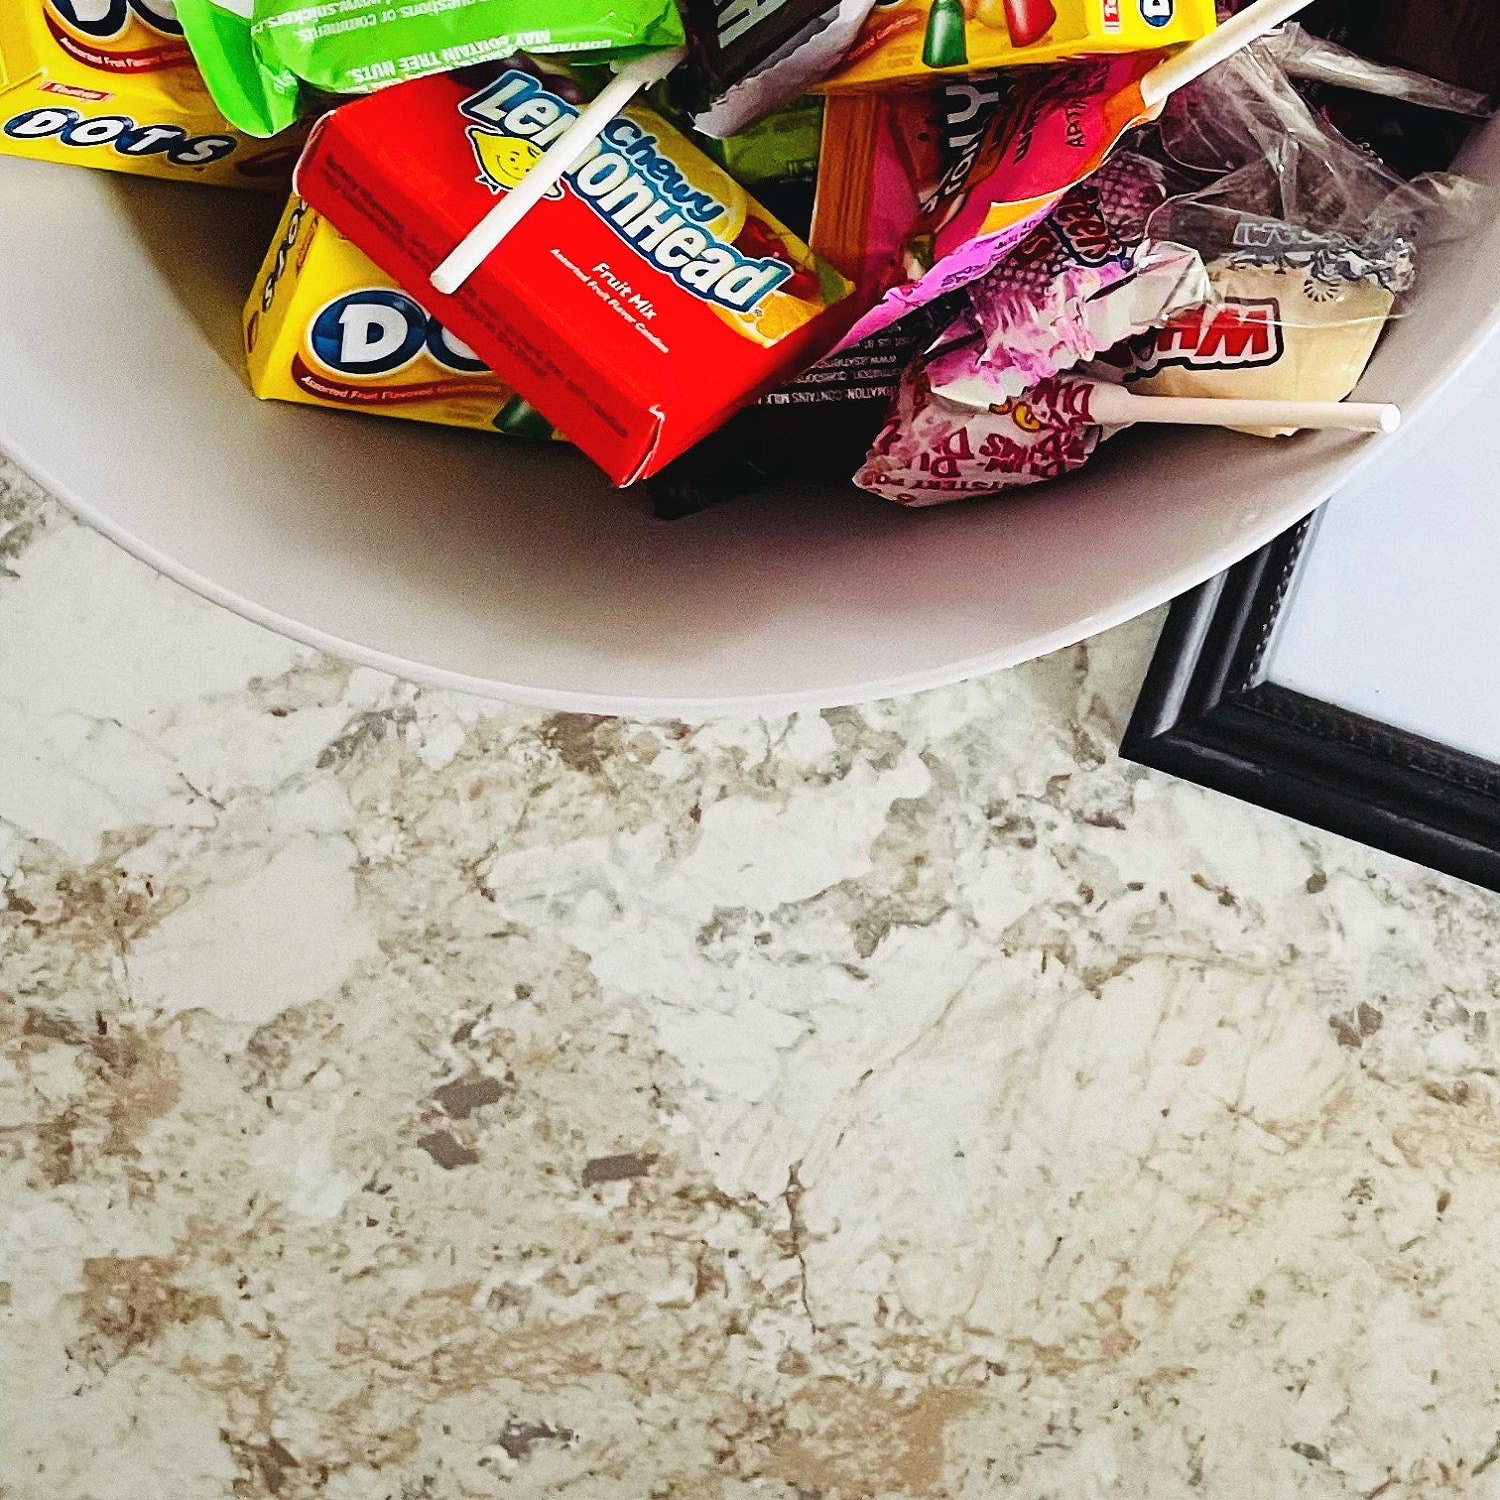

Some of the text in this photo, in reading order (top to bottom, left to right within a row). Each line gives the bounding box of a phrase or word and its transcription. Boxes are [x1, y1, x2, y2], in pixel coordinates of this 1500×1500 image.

[381, 8, 397, 23] or
[440, 35, 510, 62] CONTAIN
[514, 30, 550, 46] MAY
[397, 51, 442, 72] TREE
[17, 110, 231, 163] DOTS
[604, 118, 725, 219] Chewy
[470, 78, 782, 307] LeonHead
[591, 262, 657, 320] Fruit Mix
